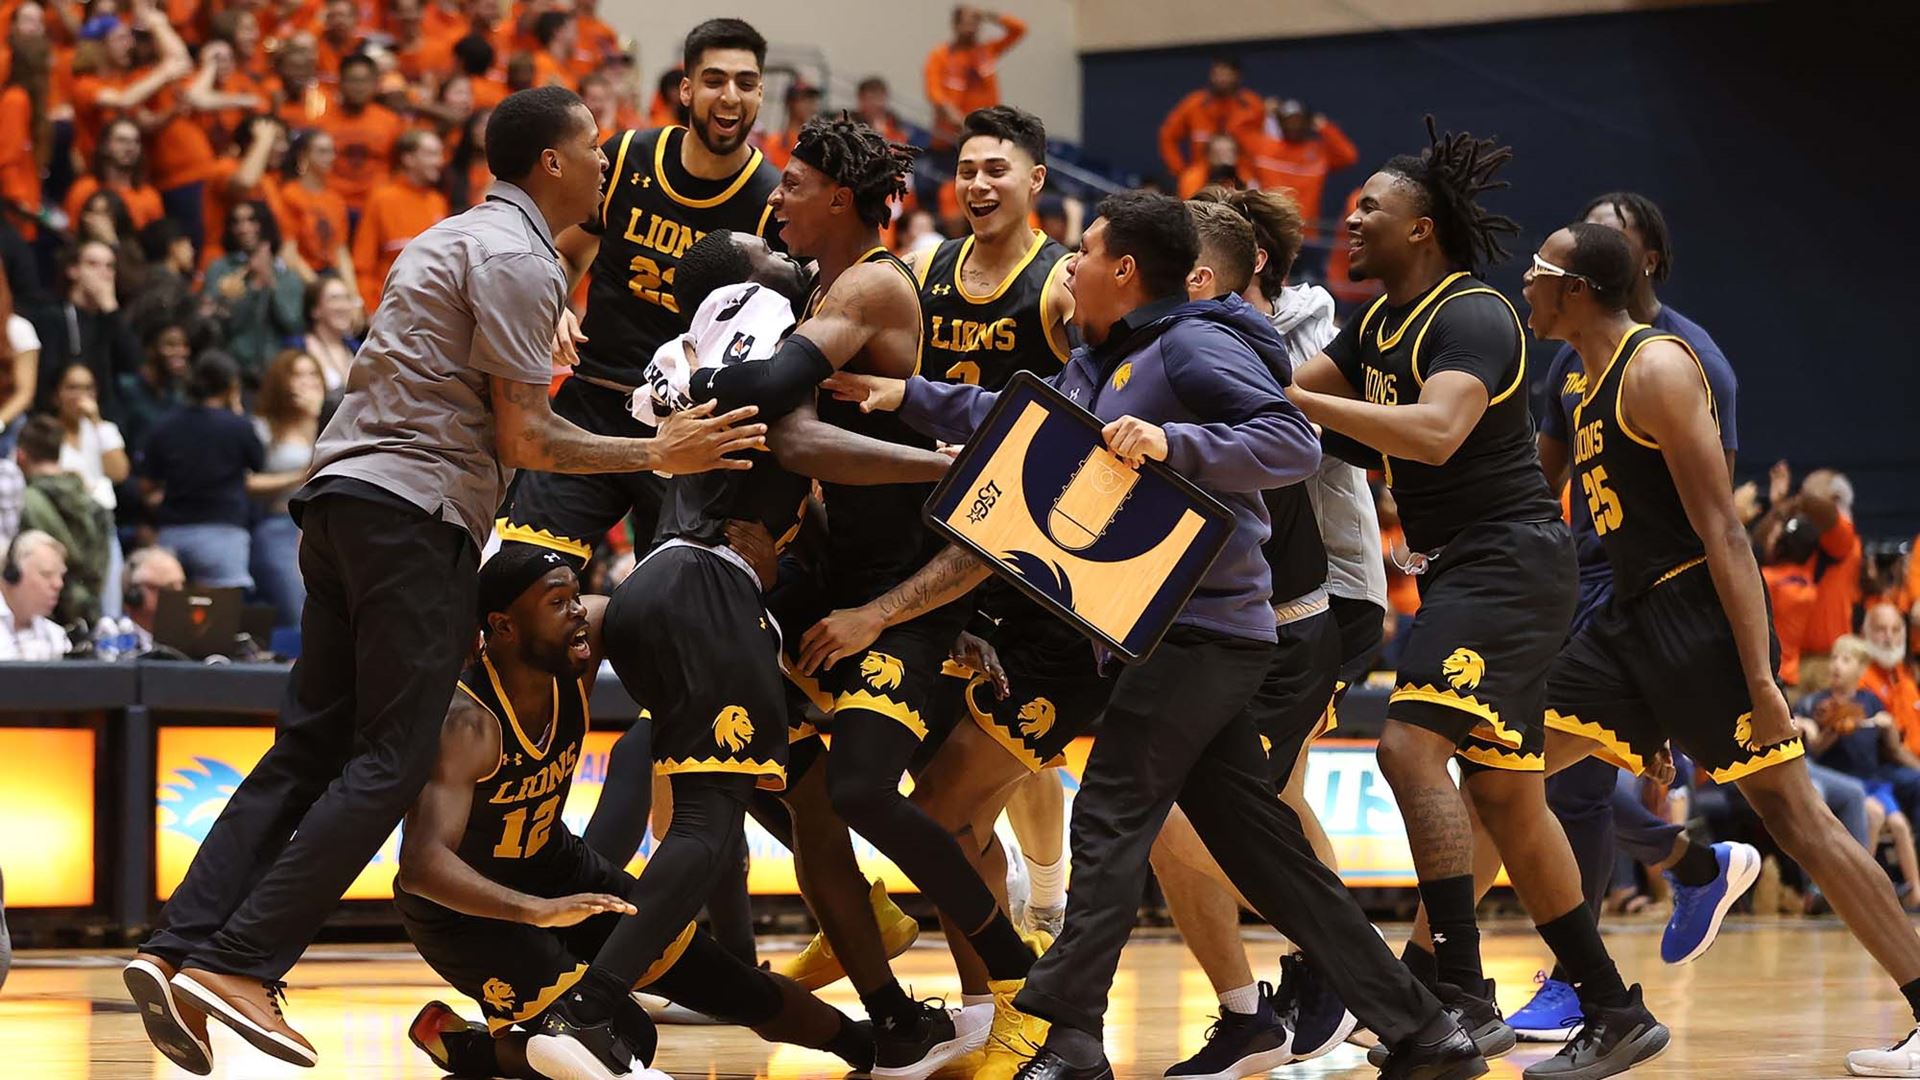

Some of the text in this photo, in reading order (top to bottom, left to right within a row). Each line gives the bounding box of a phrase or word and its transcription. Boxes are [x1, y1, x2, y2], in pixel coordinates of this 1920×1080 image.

[624, 207, 707, 259] LION
[931, 315, 1017, 352] LIONS
[1361, 362, 1398, 406] IONS
[1581, 465, 1624, 537] 25
[489, 741, 577, 804] LIONS
[493, 794, 561, 859] 12
